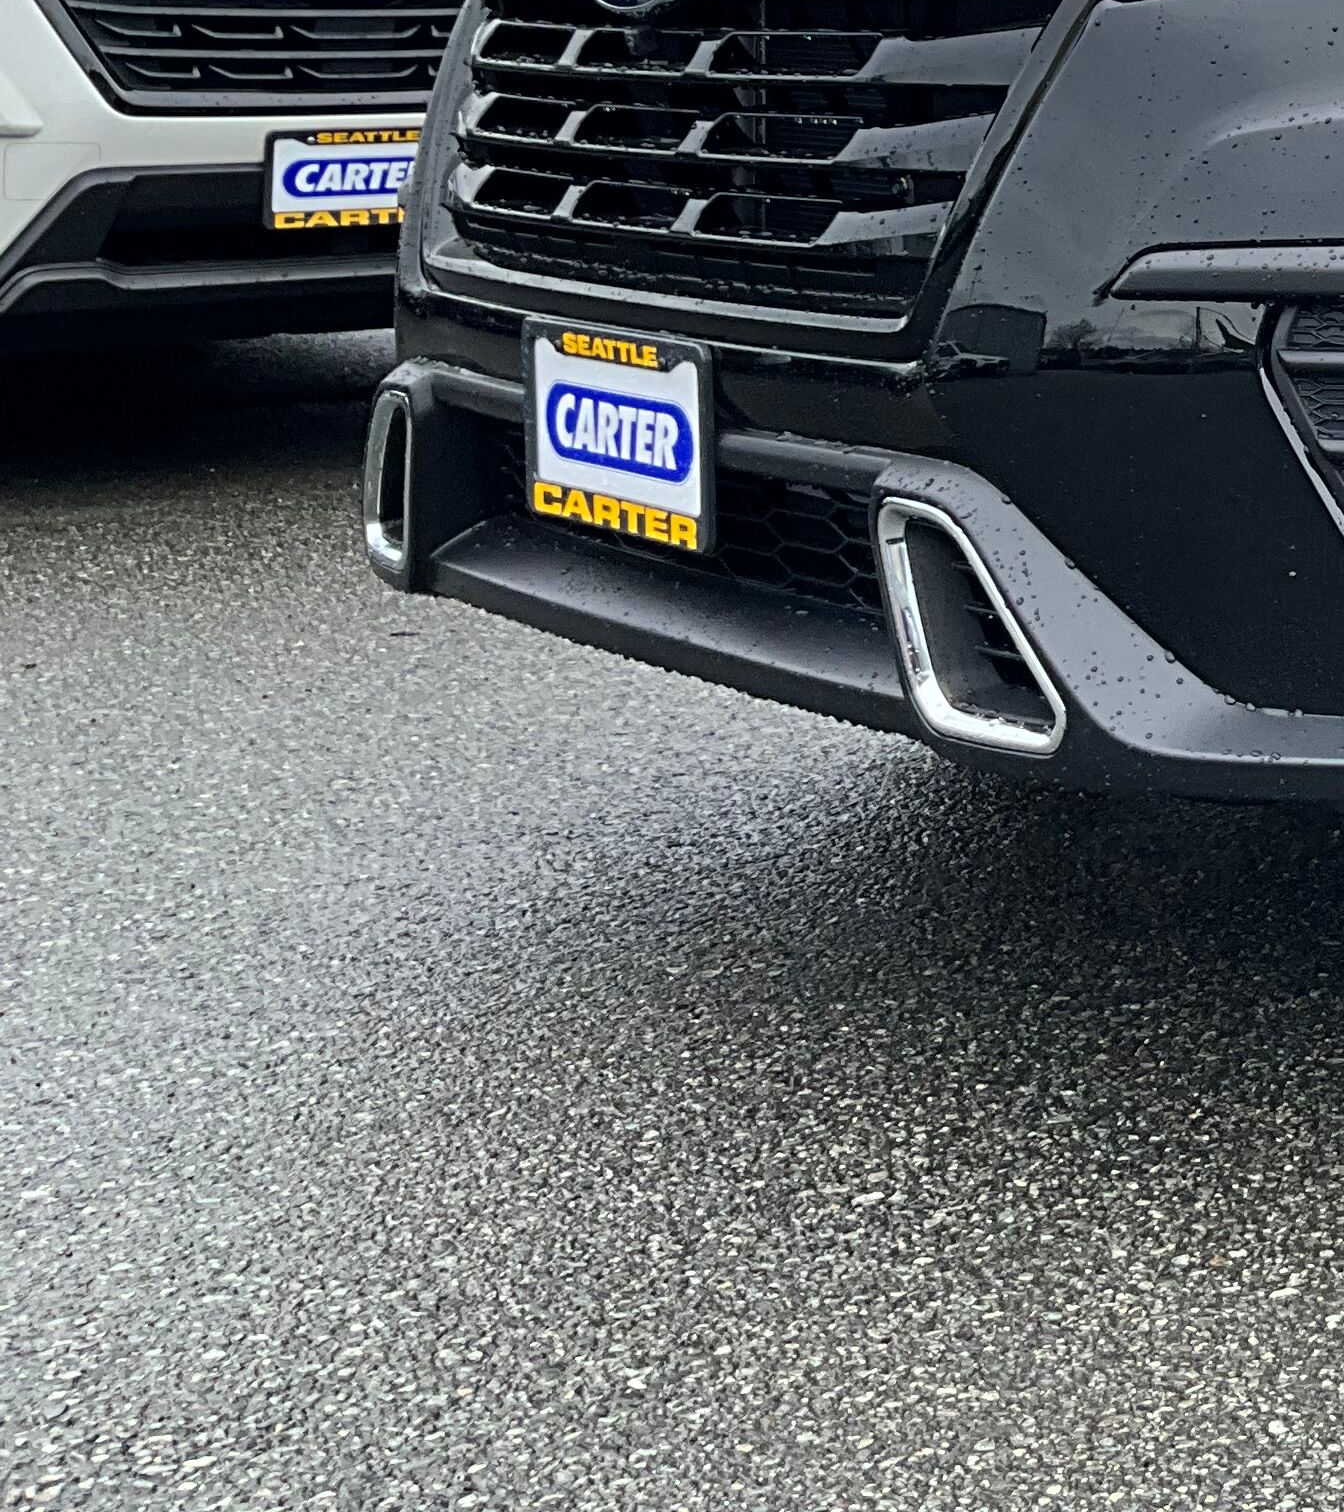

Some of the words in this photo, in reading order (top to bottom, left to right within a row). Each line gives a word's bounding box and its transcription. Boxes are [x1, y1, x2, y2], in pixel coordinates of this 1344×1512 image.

[295, 161, 415, 193] CARTE
[274, 207, 406, 229] CART
[562, 331, 658, 368] SEATTLE
[555, 393, 679, 471] CARTER
[534, 481, 697, 550] CARTER
